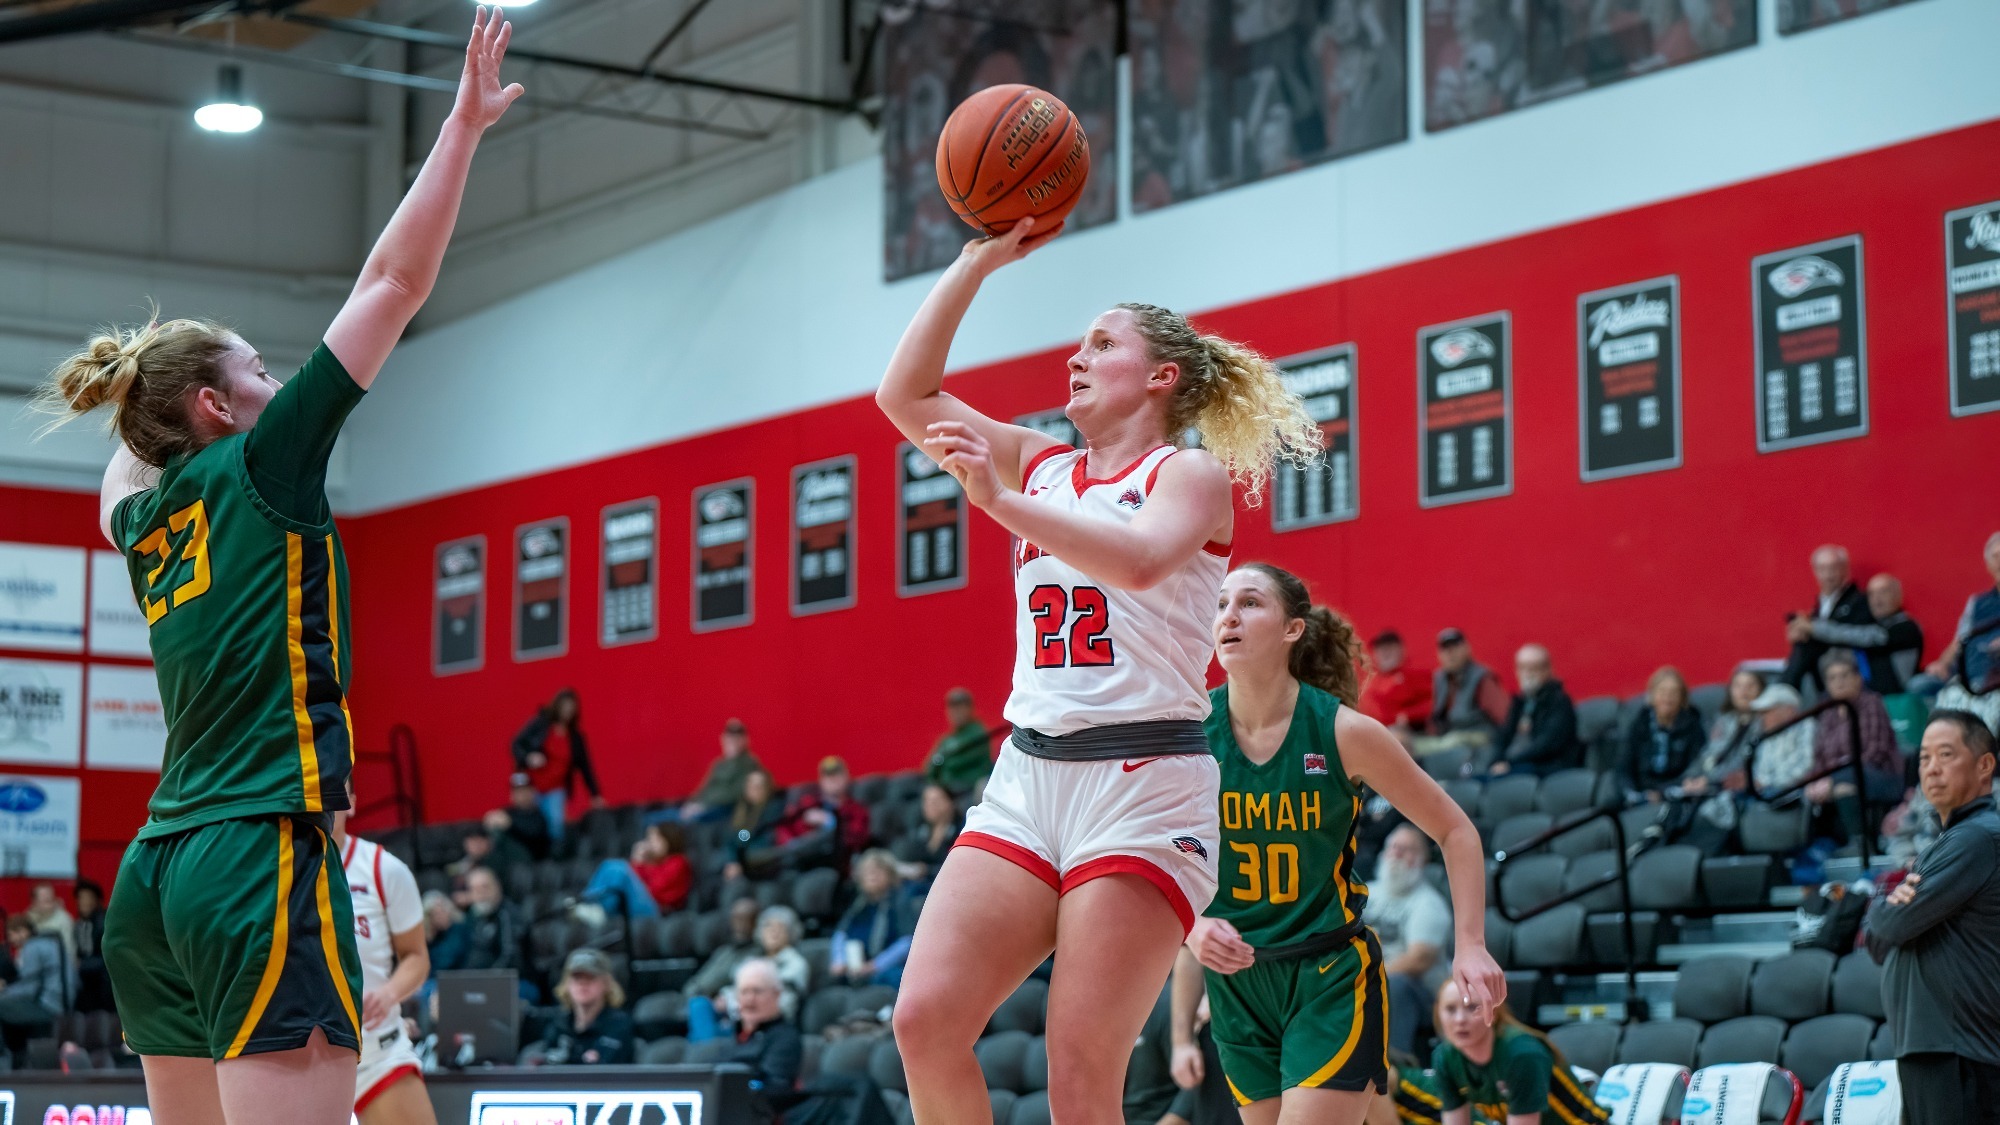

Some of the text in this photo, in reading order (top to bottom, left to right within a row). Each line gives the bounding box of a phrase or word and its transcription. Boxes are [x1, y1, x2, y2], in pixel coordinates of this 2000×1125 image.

[1007, 102, 1062, 171] LEGACY
[132, 499, 211, 627] 23
[1029, 584, 1114, 669] 22
[1219, 790, 1321, 831] OMAH
[1229, 840, 1299, 905] 30
